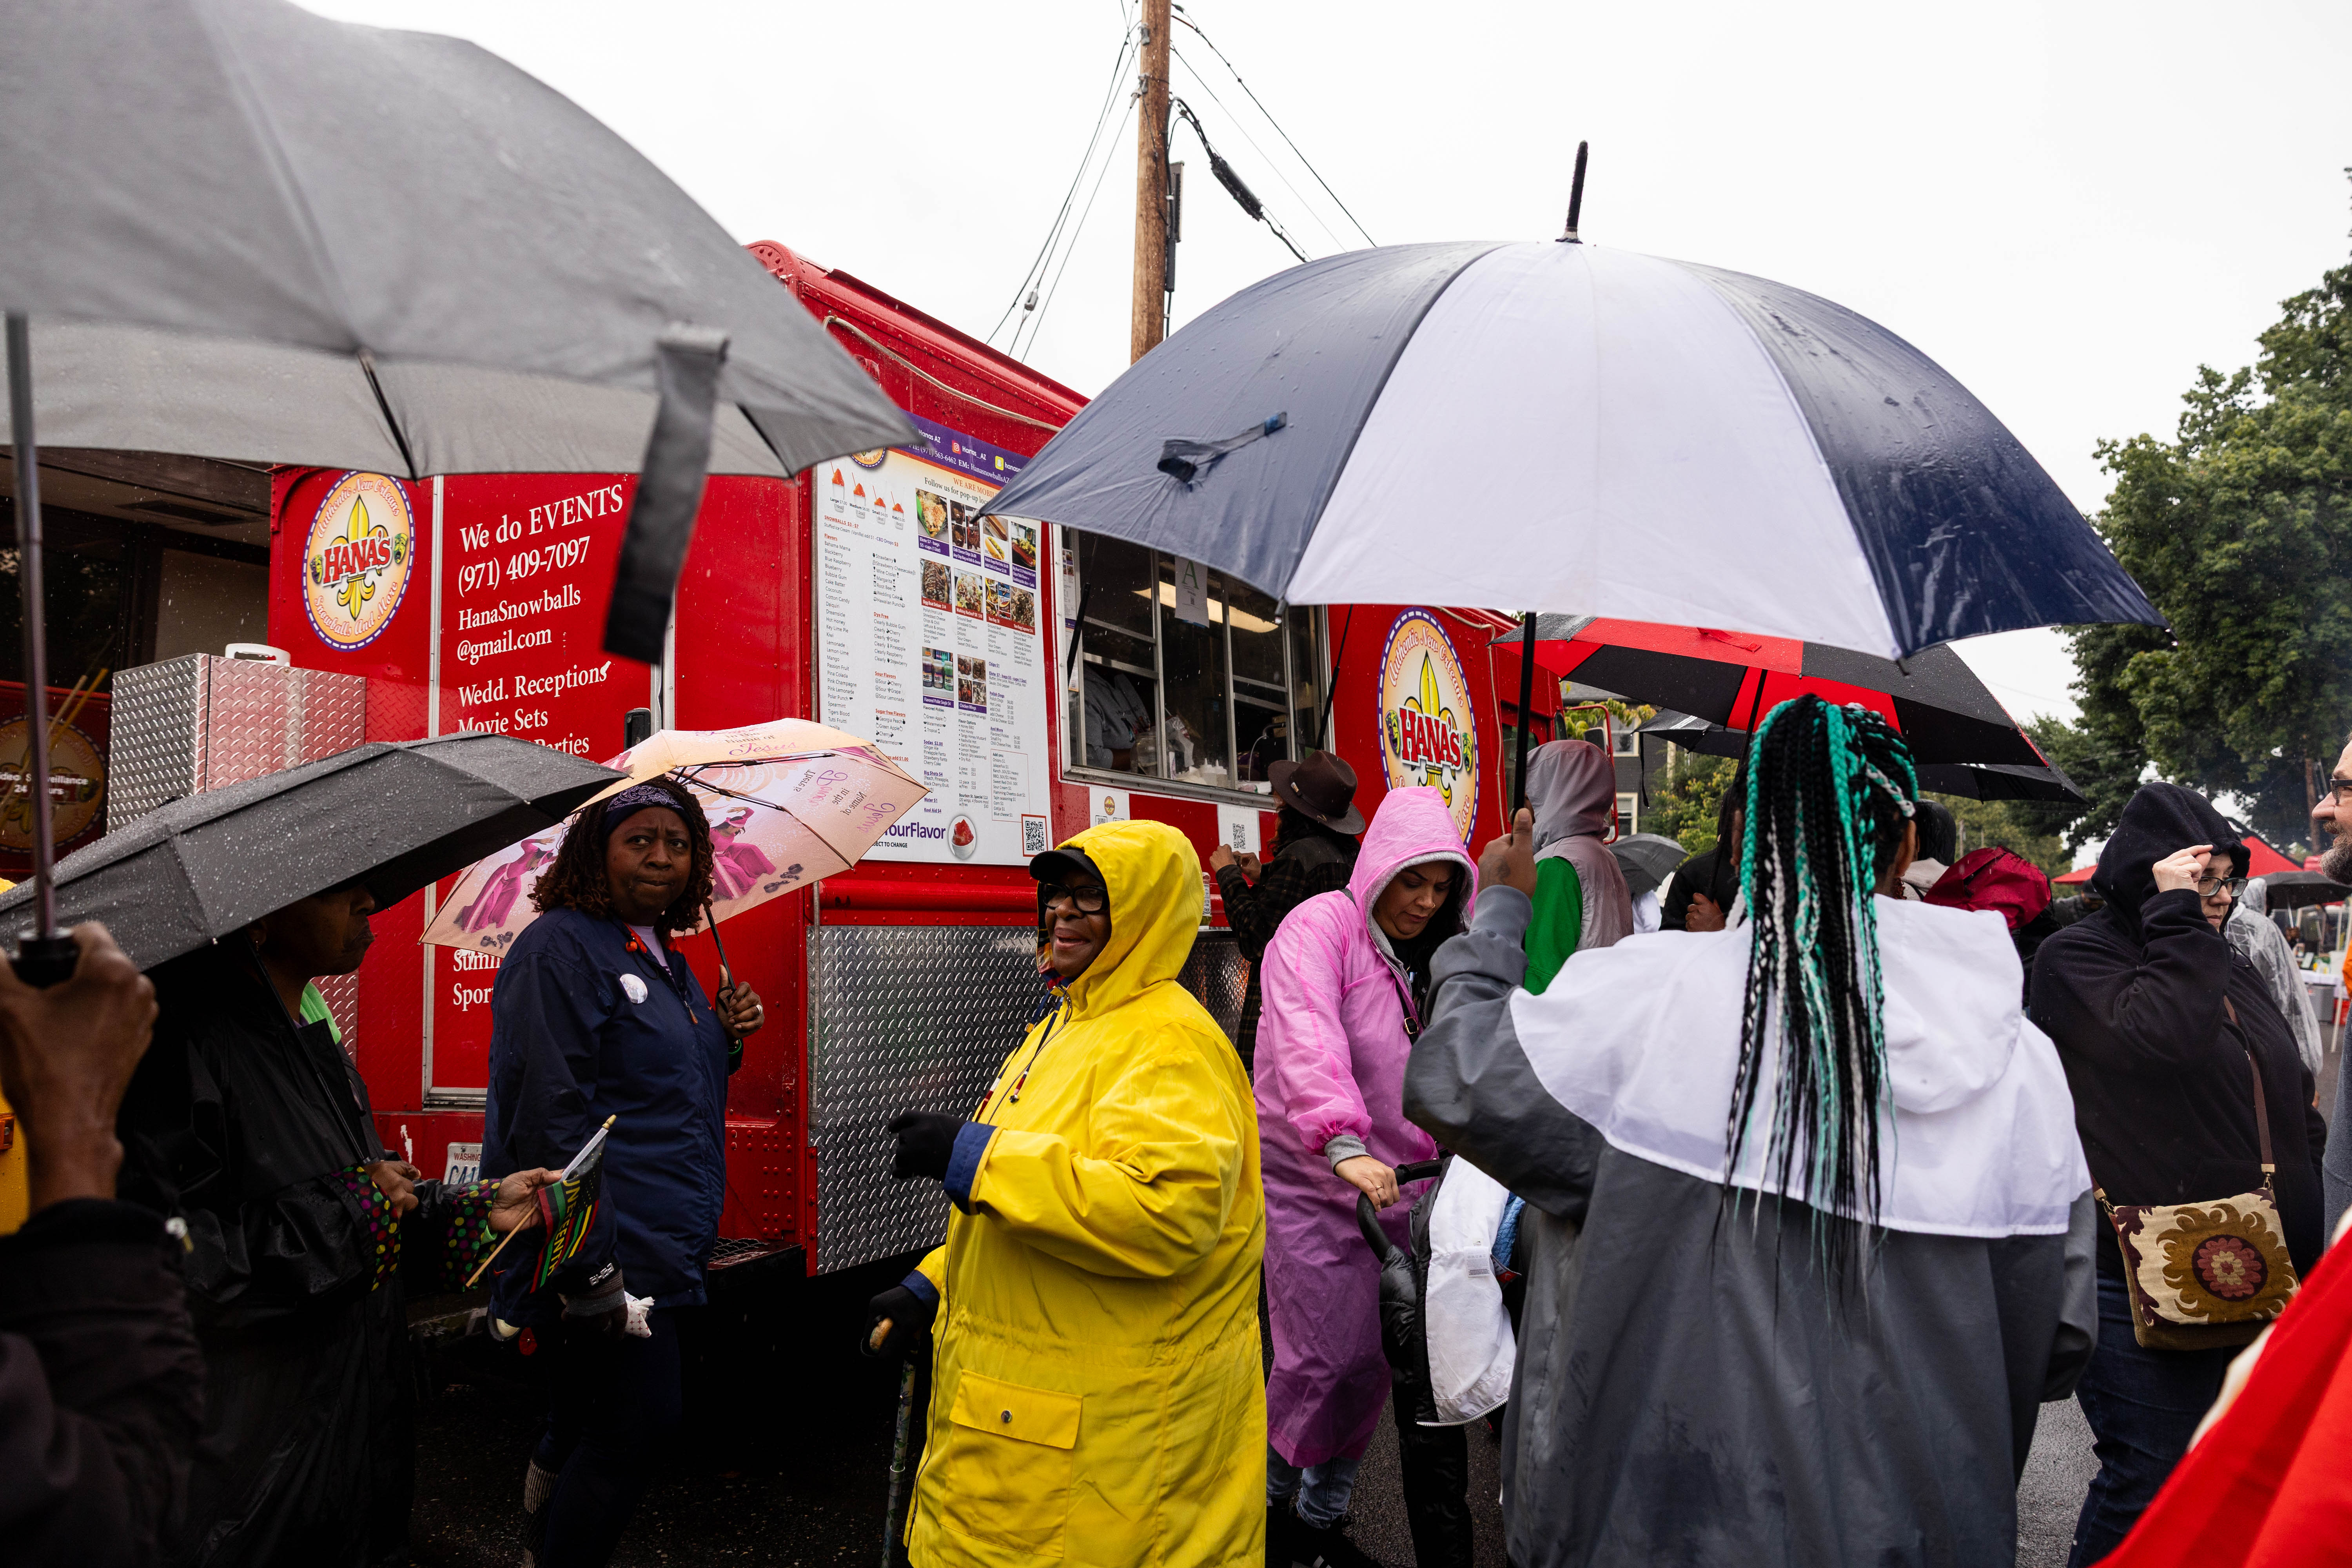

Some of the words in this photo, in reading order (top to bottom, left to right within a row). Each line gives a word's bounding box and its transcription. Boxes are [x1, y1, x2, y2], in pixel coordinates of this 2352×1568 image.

[918, 429, 934, 440] Hanas
[920, 445, 933, 457] (971)
[935, 451, 956, 464] 563-6462
[958, 459, 969, 469] EM:
[971, 463, 1012, 483] HanasnowballsAZ
[924, 477, 943, 489] Follow
[960, 491, 978, 503] pop-up
[953, 478, 963, 487] WE
[965, 482, 976, 491] ARE
[317, 486, 352, 539] Authentic
[353, 477, 374, 494] New
[374, 479, 400, 516] Orleans
[459, 523, 489, 552] We
[496, 514, 522, 544] do
[529, 485, 623, 535] EVENTS
[825, 515, 846, 525] SNOWBALLS
[323, 528, 392, 586] HANA'S
[458, 557, 500, 597] (971)
[506, 536, 590, 580] 409-7097
[825, 548, 843, 558] Blackberry
[833, 558, 851, 567] Raspberry
[825, 563, 842, 572] Blueberry
[1182, 561, 1200, 590] A
[314, 595, 352, 636] Snowballs
[354, 612, 374, 636] And
[377, 581, 397, 620] More
[458, 584, 581, 630] HanaSnowballs
[457, 629, 552, 665] @gmail.com
[1388, 628, 1419, 687] Authentic
[1420, 625, 1438, 653] New
[1438, 645, 1464, 707] Orleans
[458, 678, 509, 707] Wedd.
[514, 664, 608, 697] Receptions
[458, 712, 509, 733] Movie
[514, 708, 548, 730] Sets
[729, 742, 797, 756] Jesus
[1398, 704, 1462, 771] HANA'S
[14, 784, 27, 793] 24
[454, 1153, 481, 1161] WASHING
[448, 1165, 476, 1184] CA1
